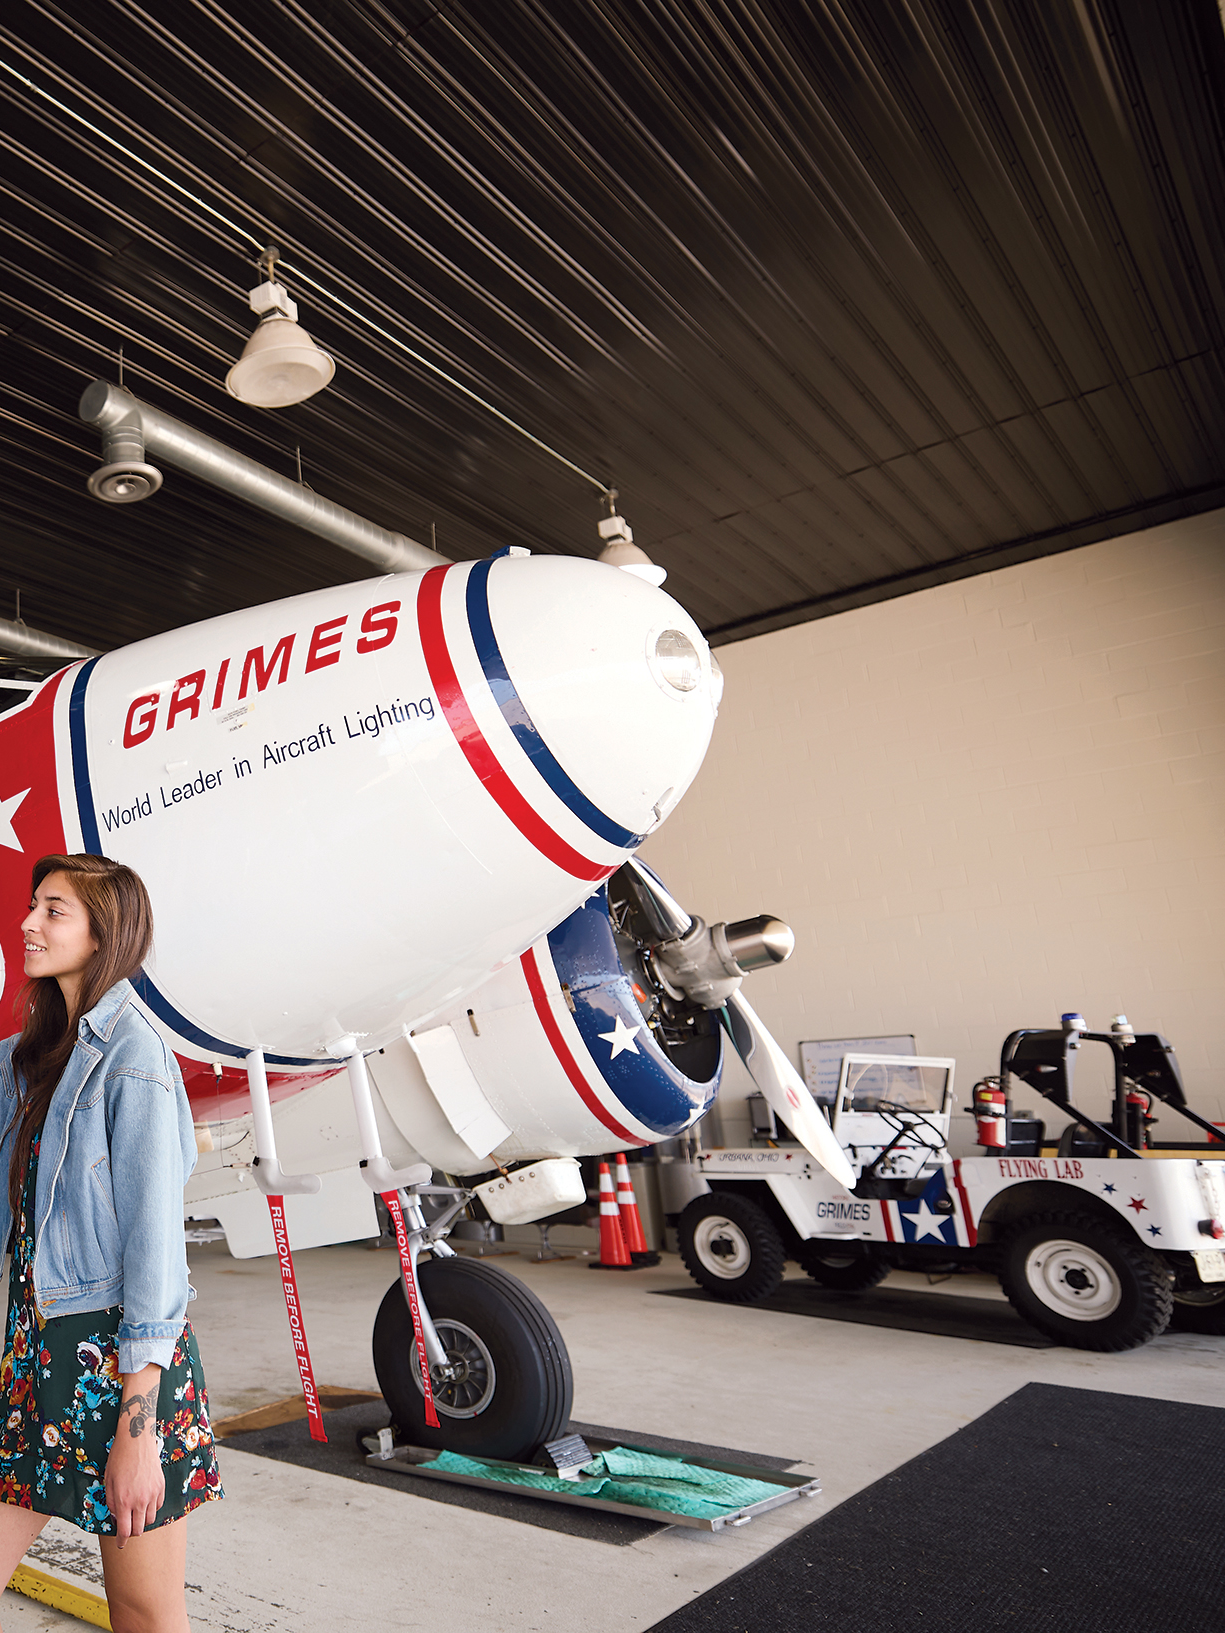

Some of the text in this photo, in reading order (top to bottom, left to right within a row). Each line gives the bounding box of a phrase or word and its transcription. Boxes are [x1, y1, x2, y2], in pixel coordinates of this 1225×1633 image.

[122, 600, 402, 750] GRIMES
[102, 696, 435, 832] World Leader in Aircraft Lighting
[757, 1152, 779, 1162] OHIO
[817, 1201, 871, 1221] GRIMES
[998, 1159, 1084, 1179] FLYING LAB
[271, 1206, 318, 1419] REMOVE BEFORE FLIGHT
[387, 1199, 432, 1402] REMOVE BEFORE FLIGHT
